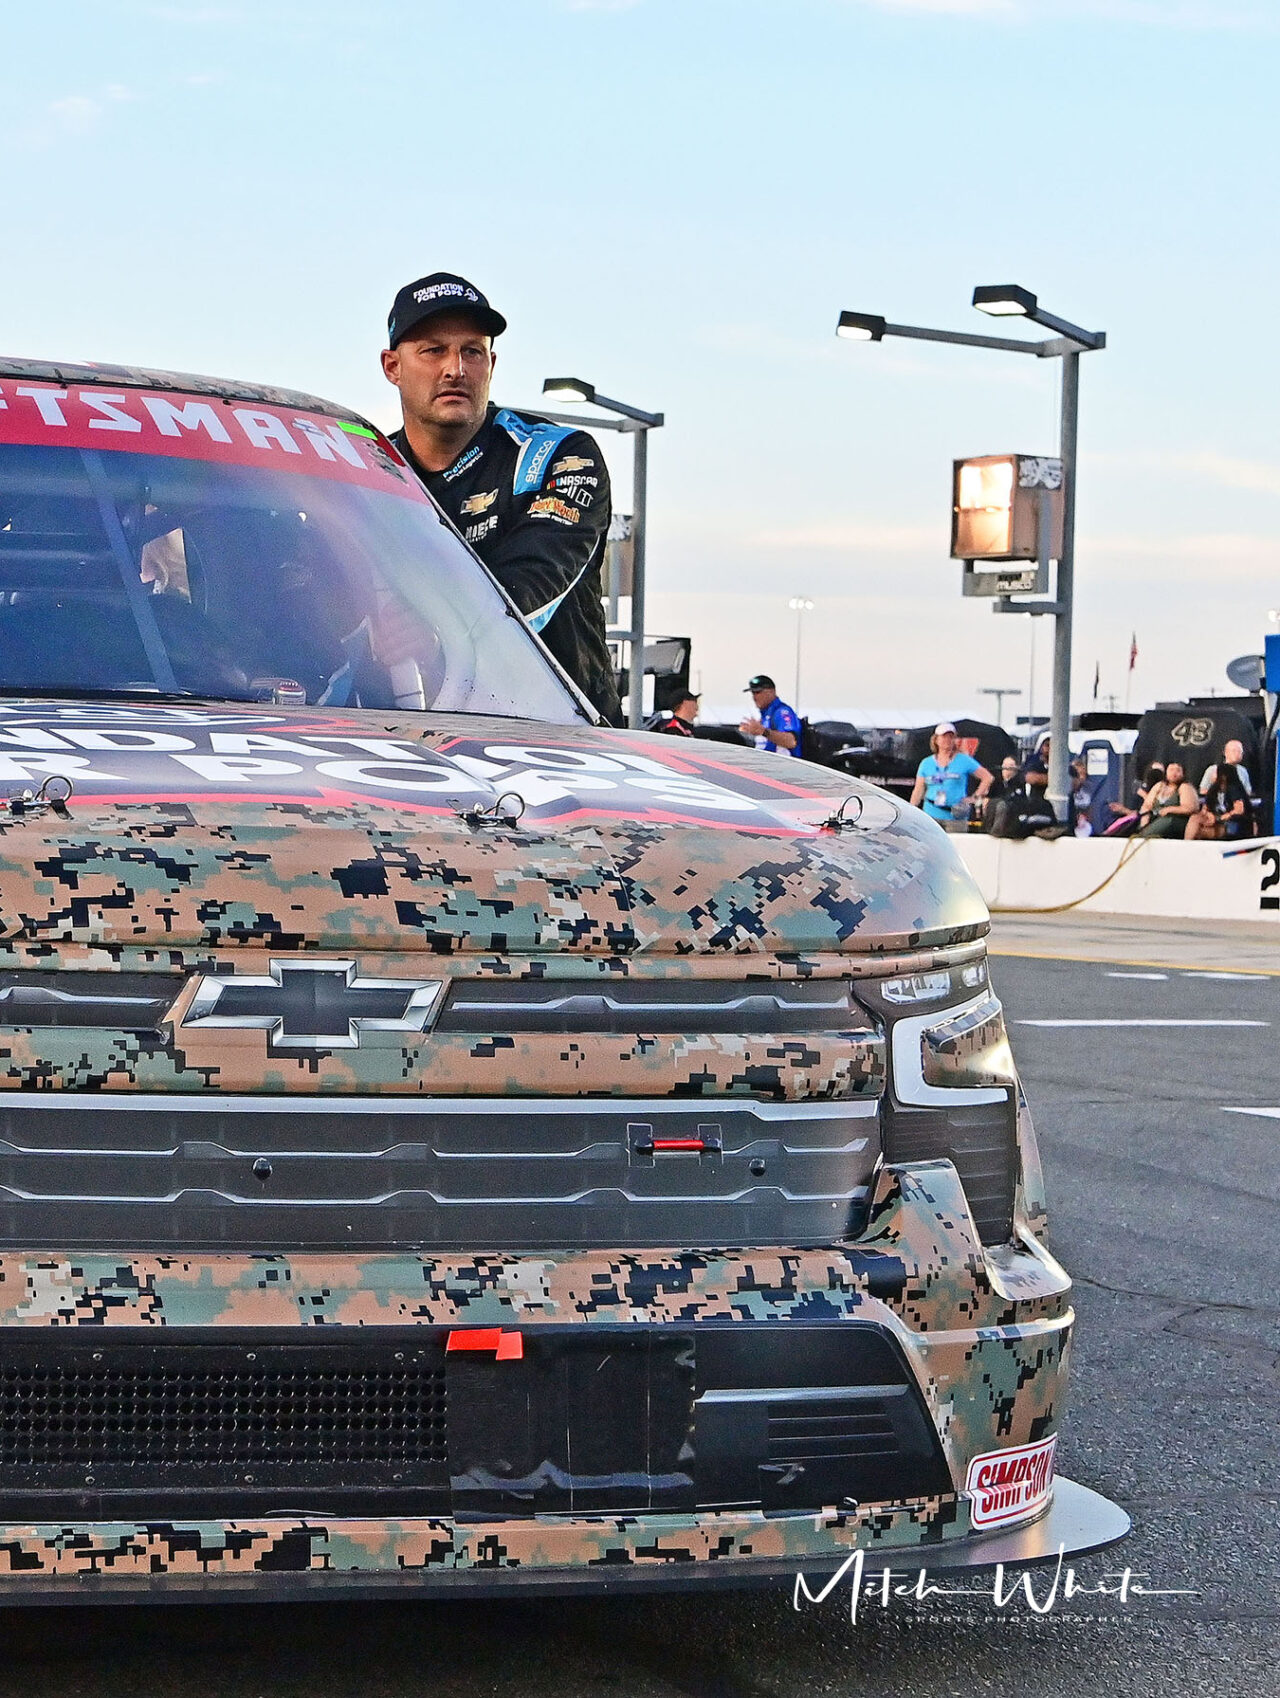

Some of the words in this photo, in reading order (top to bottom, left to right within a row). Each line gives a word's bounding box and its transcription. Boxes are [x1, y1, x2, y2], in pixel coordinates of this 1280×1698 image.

[412, 282, 464, 300] FOUNDATION
[442, 445, 481, 480] Precision
[525, 440, 556, 485] sparco
[560, 474, 599, 489] NASCAR
[169, 754, 760, 811] POPS
[977, 1446, 1054, 1514] SIMPSON
